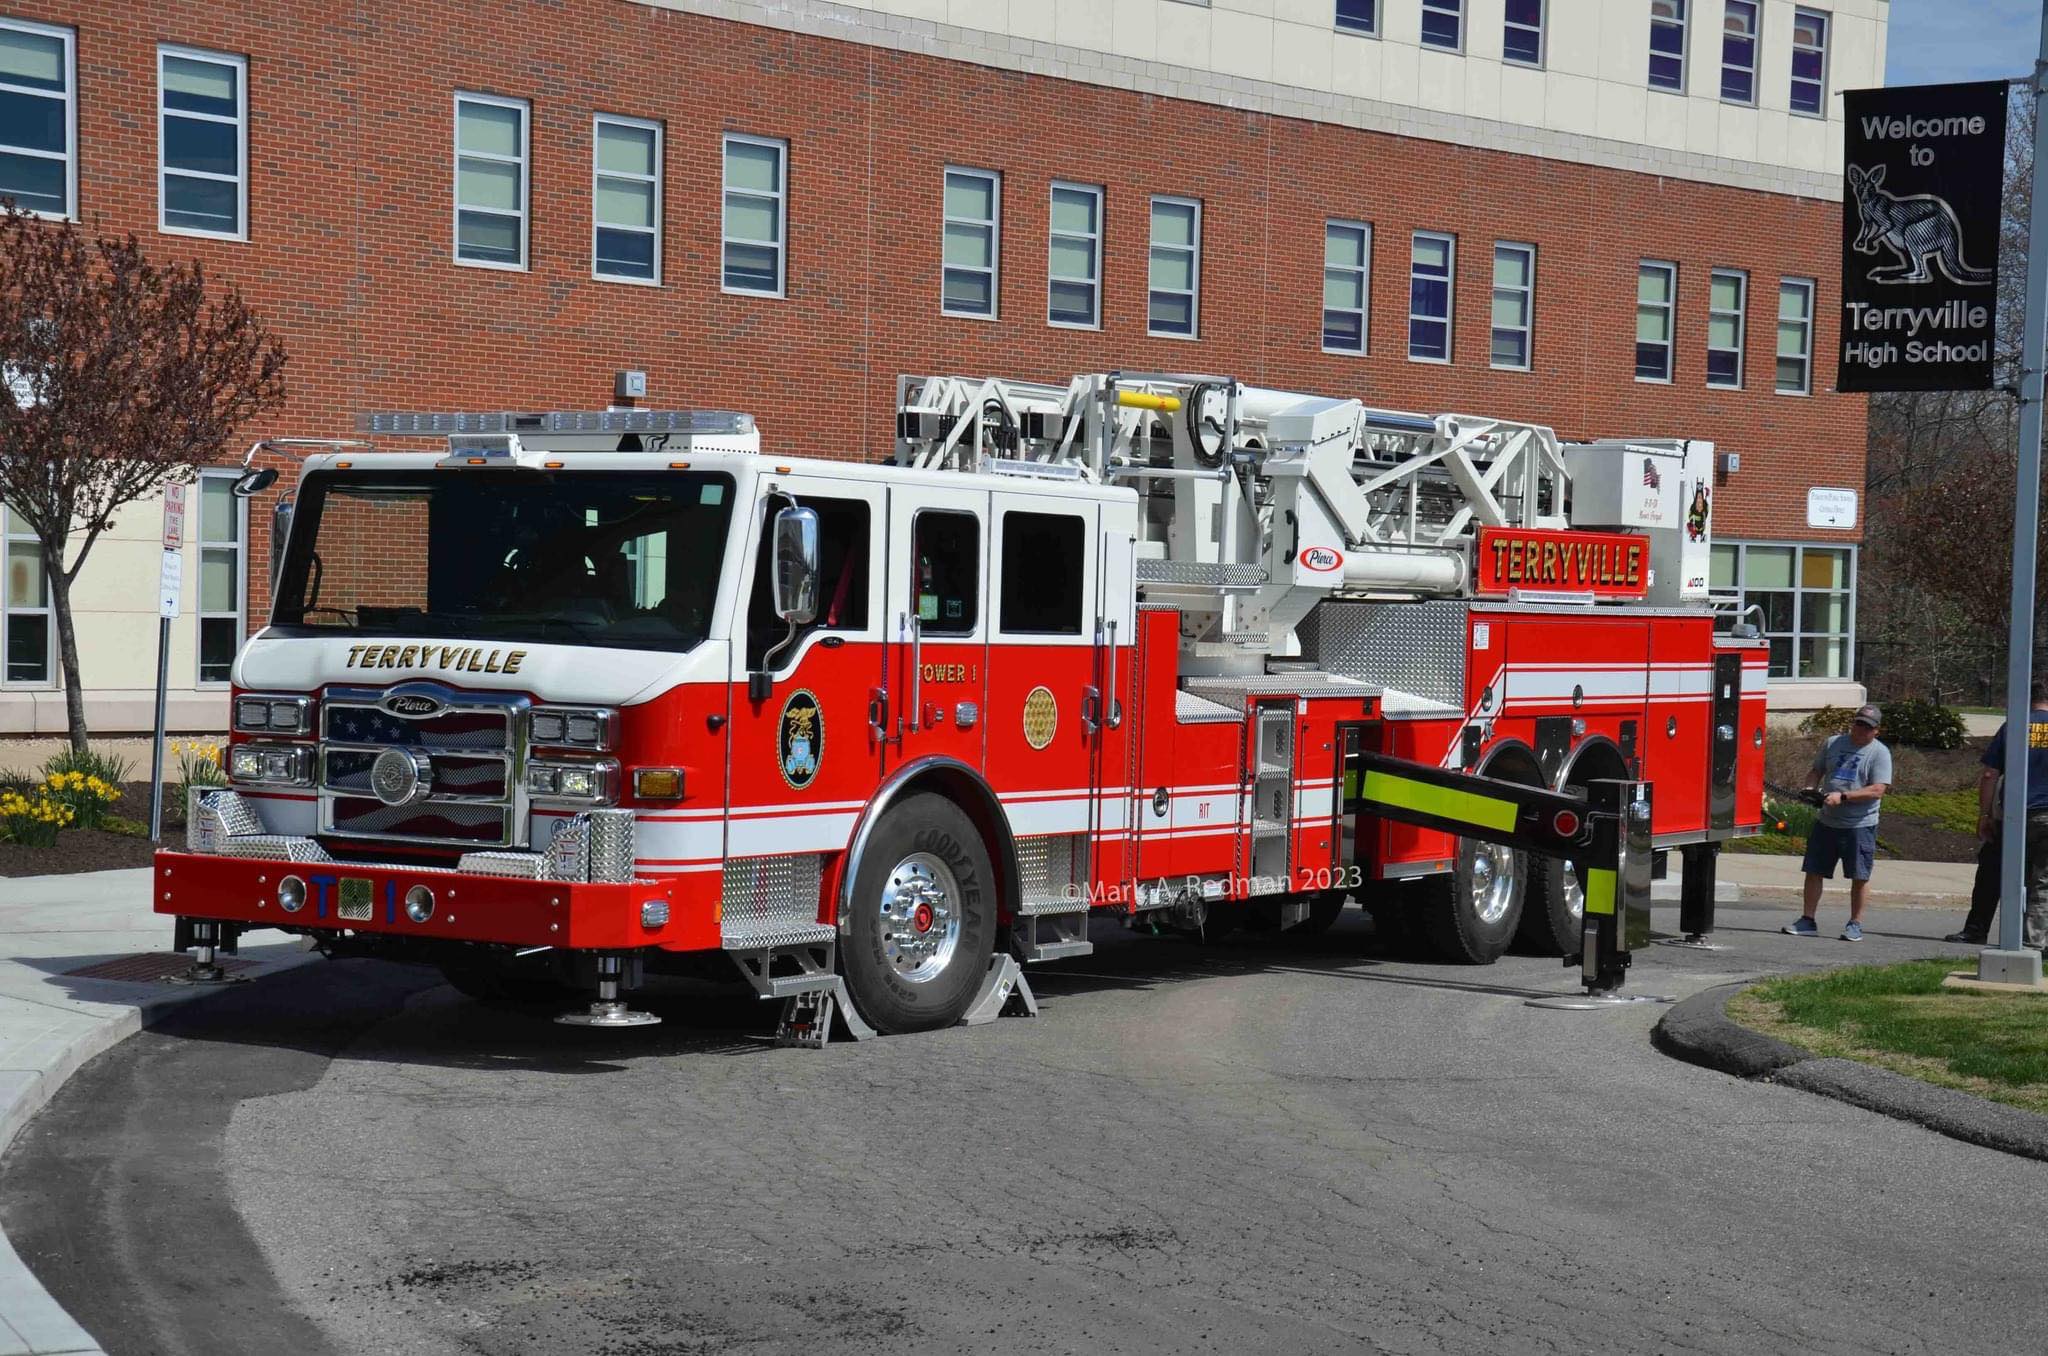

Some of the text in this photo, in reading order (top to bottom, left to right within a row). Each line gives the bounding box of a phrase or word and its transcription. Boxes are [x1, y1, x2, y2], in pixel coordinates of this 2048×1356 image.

[1861, 114, 1986, 140] Welcome
[1909, 143, 1935, 167] to
[1846, 300, 1988, 337] Terryville
[1845, 340, 1988, 369] High School
[171, 486, 180, 498] NO
[166, 501, 184, 515] PARKING
[1309, 549, 1334, 567] Pierce
[1492, 538, 1641, 586] TERRYVILLE
[347, 645, 527, 674] TERRYVILLE
[394, 697, 432, 713] Pierce
[1198, 803, 1210, 819] RIT
[311, 875, 337, 918] T
[913, 828, 982, 950] GOODYEAR
